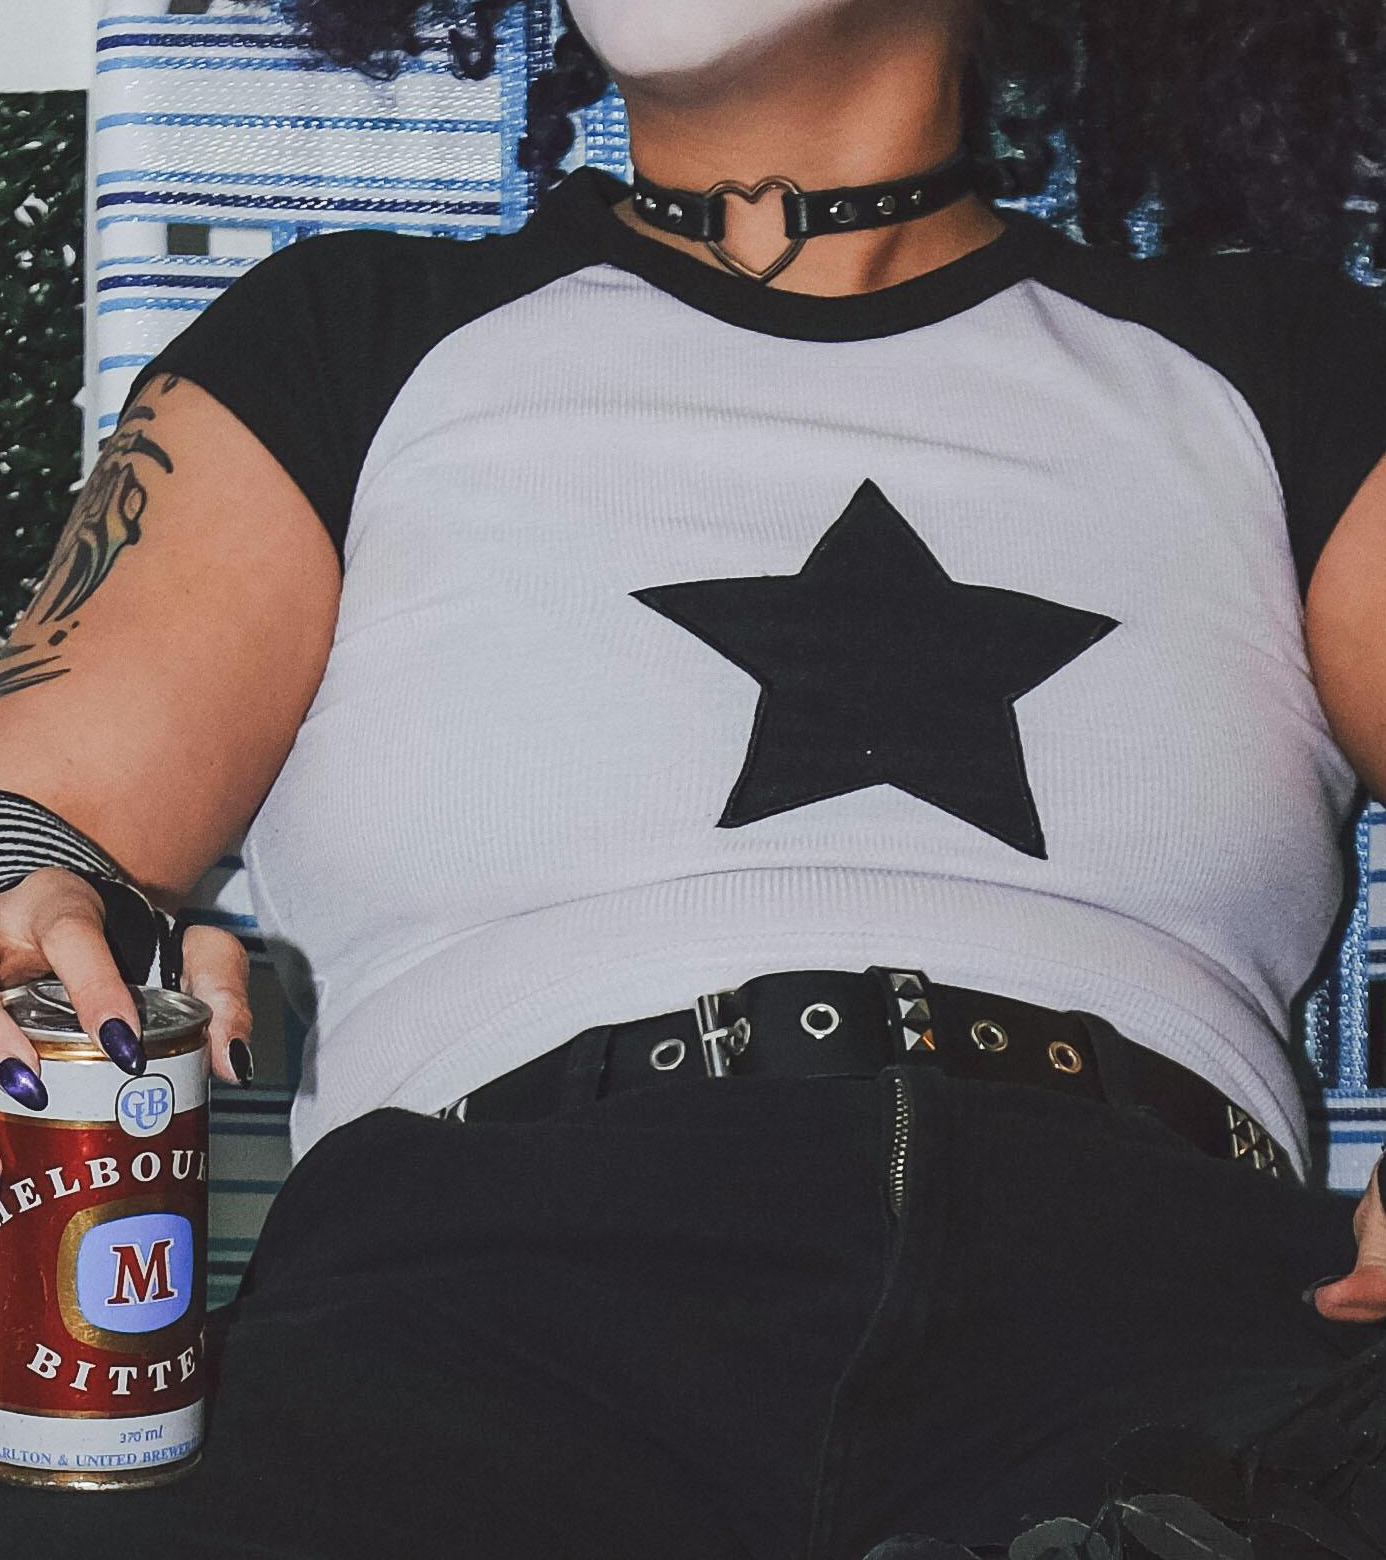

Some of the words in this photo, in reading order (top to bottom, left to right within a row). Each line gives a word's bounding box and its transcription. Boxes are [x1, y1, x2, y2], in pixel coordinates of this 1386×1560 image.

[104, 1238, 178, 1306] M
[26, 1343, 195, 1395] BITTE
[120, 1431, 142, 1444] 370
[145, 1425, 164, 1441] ml
[58, 1454, 68, 1466] &
[76, 1453, 137, 1467] UNITED
